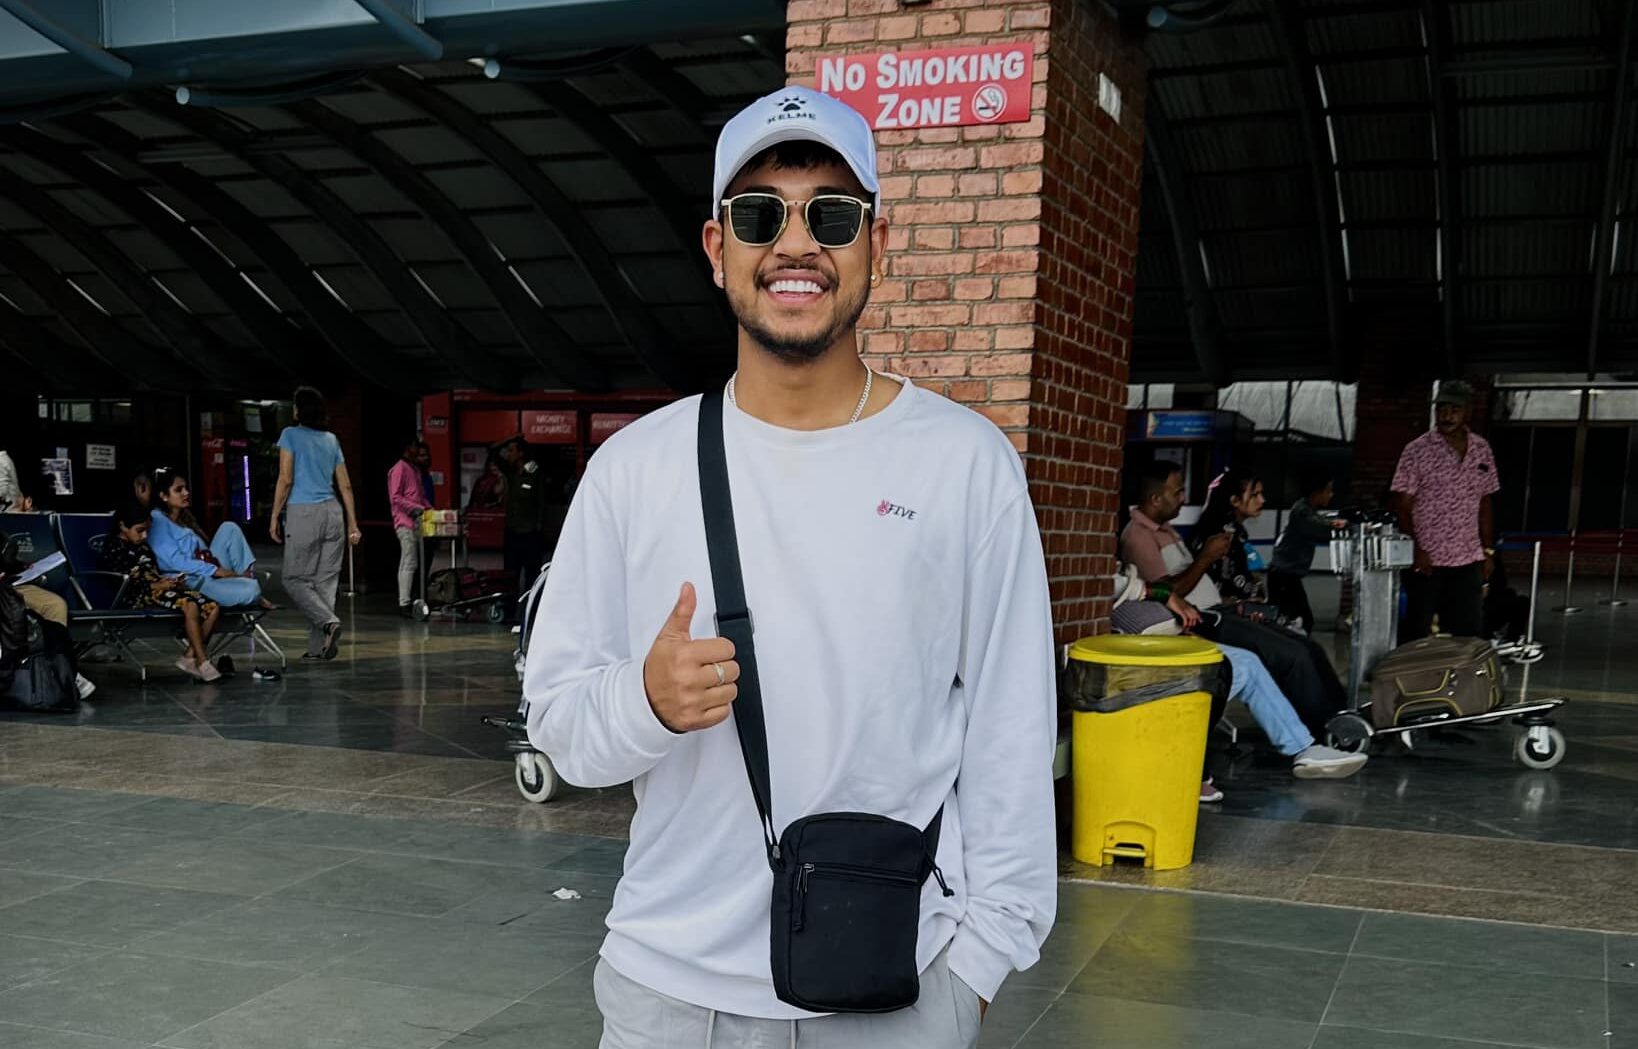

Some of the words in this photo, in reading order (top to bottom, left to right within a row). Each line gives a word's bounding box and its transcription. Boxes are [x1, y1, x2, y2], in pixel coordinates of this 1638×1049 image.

[821, 57, 866, 93] NO
[875, 51, 1025, 89] SMOKING
[875, 93, 961, 128] ZONE
[767, 112, 817, 124] KELME
[536, 414, 565, 424] MONEY
[531, 424, 572, 434] EXCHANGE
[887, 503, 917, 520] FIVE
